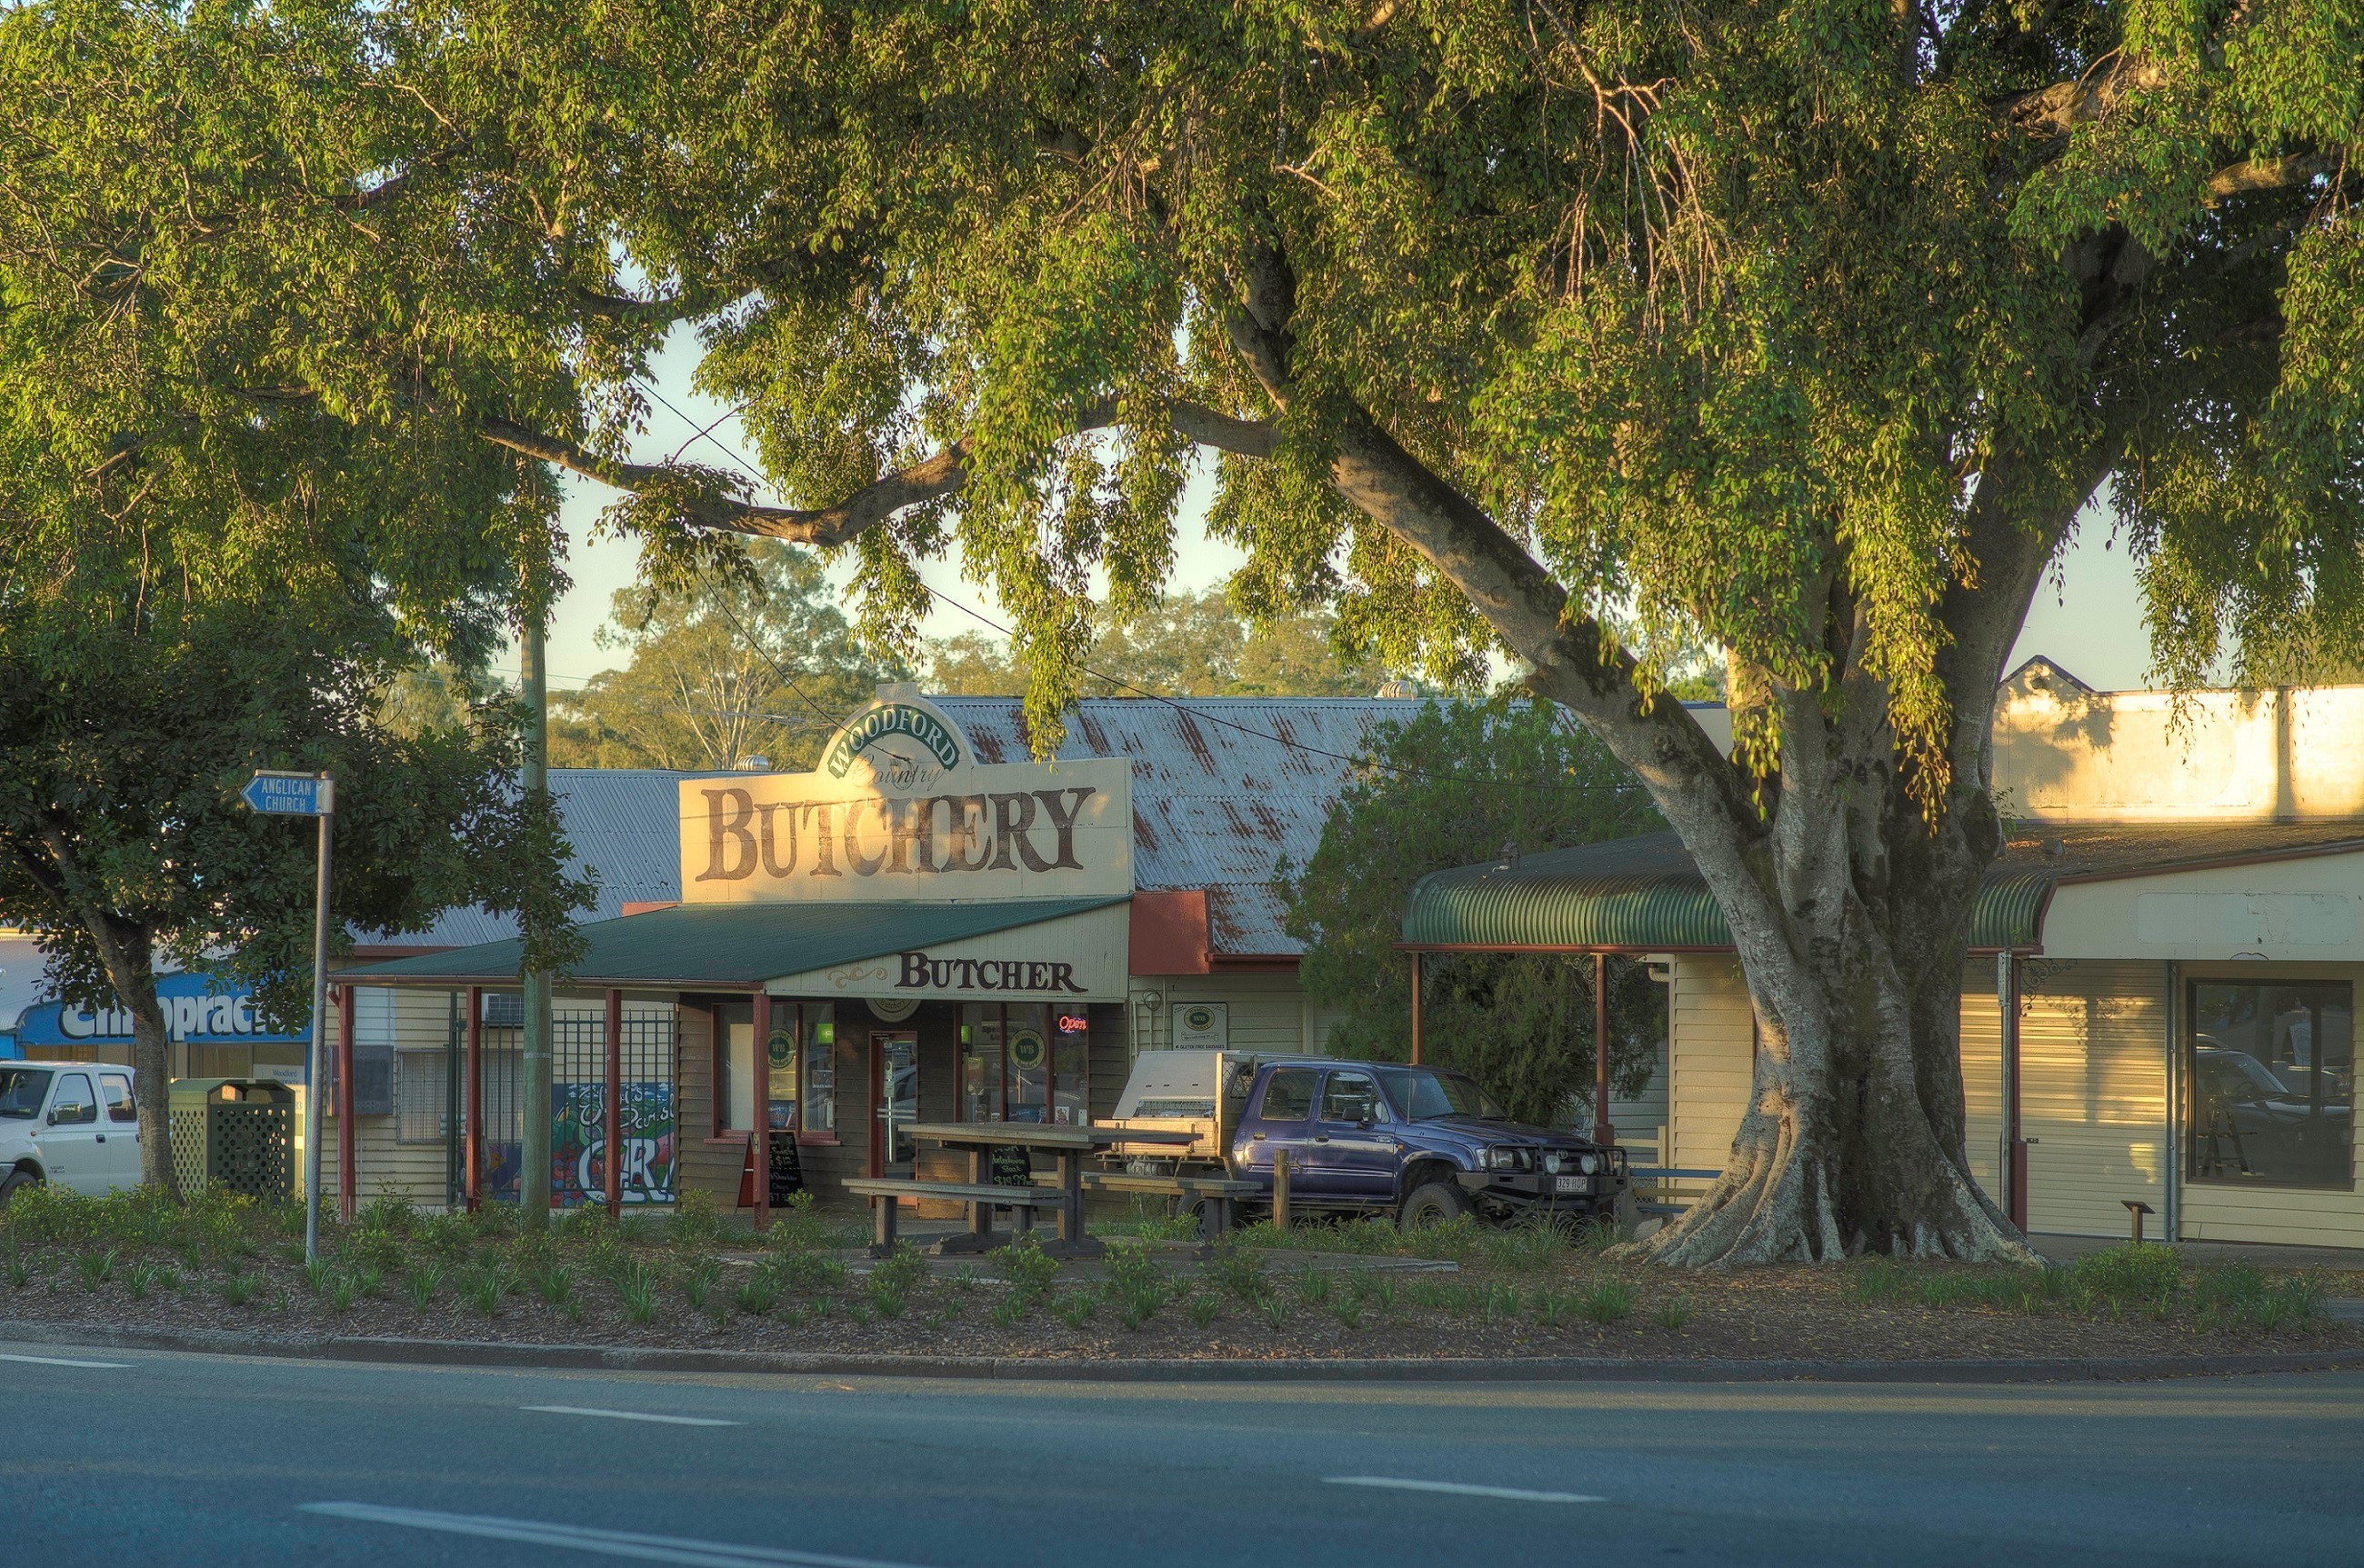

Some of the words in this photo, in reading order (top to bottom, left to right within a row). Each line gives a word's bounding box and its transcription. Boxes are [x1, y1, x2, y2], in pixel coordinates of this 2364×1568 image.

[830, 708, 957, 775] WOODFORD
[853, 753, 945, 792] Country
[261, 778, 311, 796] ANGLICAN
[265, 795, 306, 813] CHURCH
[695, 787, 1097, 883] BUTCHERY
[894, 952, 1089, 994] BUTCHER
[1059, 1015, 1087, 1032] Open
[772, 1044, 786, 1053] WB
[1019, 1044, 1035, 1054] WB
[1558, 1178, 1570, 1188] 329
